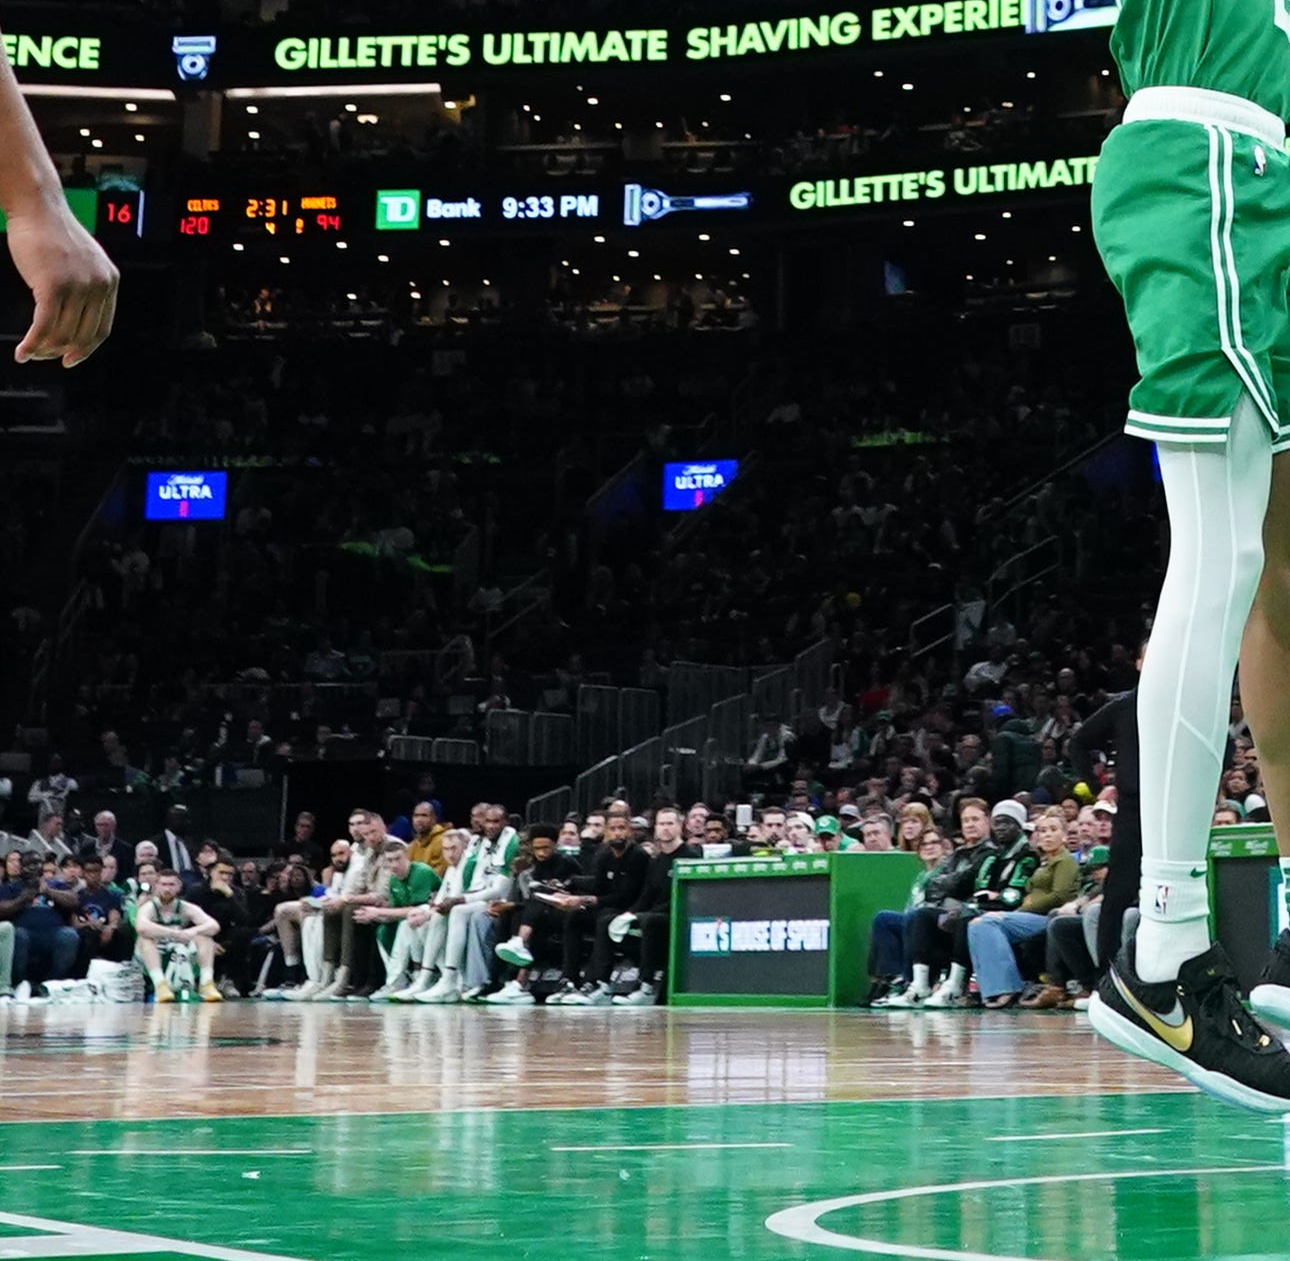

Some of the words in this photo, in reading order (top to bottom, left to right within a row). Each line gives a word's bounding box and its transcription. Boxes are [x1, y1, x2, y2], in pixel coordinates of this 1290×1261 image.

[274, 33, 472, 71] GILLETTE'S
[482, 29, 668, 67] ULTIMATE
[685, 9, 861, 61] SHAVING
[789, 170, 946, 211] GILLETTE'S
[106, 202, 131, 223] 16
[380, 196, 417, 222] TD
[426, 198, 481, 218] Bank
[502, 195, 554, 219] 9:33
[559, 194, 599, 217] PM
[180, 216, 209, 234] 120
[316, 213, 341, 230] 94
[674, 472, 727, 490] ULTRA
[158, 484, 215, 500] ULTRA
